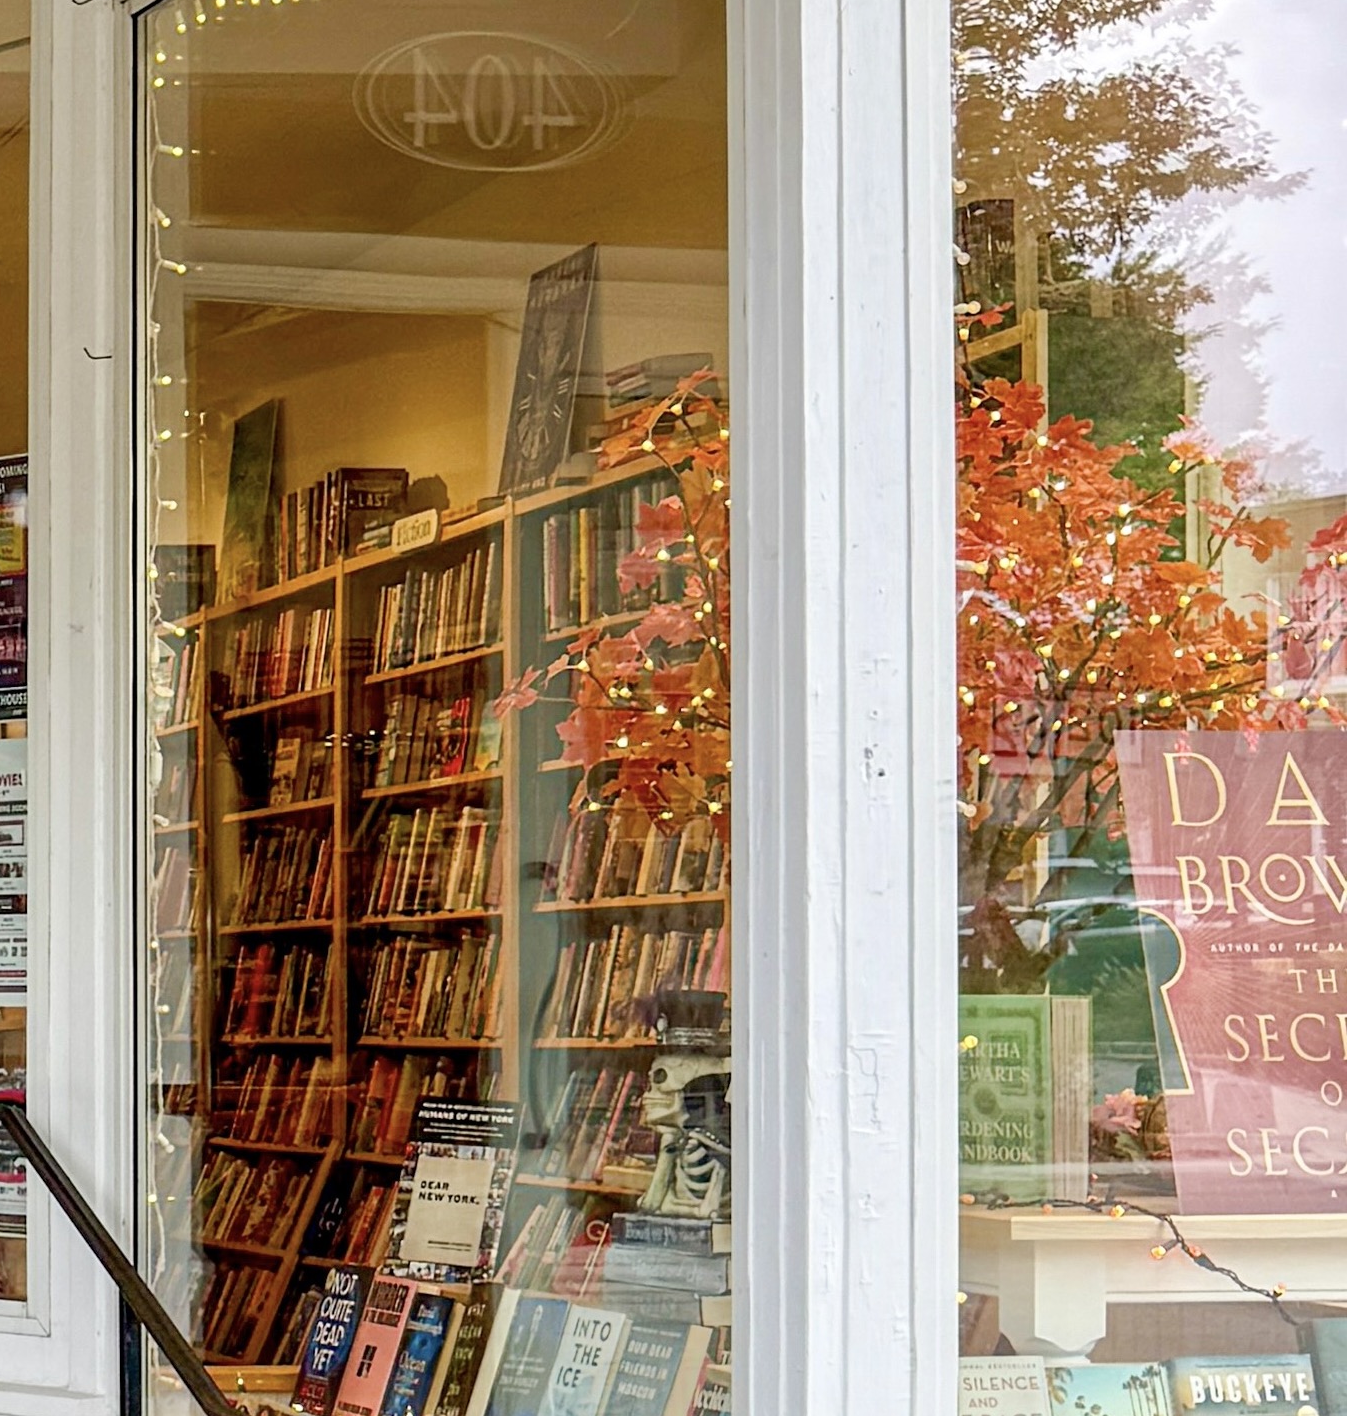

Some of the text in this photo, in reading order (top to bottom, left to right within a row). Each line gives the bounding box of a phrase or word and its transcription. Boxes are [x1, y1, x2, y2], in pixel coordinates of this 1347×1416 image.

[1210, 942, 1260, 953] AUTHOR
[1269, 942, 1285, 953] OF
[1295, 942, 1319, 953] THE
[1287, 968, 1347, 994] TH
[417, 1109, 515, 1125] HUMANS OF NEW YORK
[959, 1143, 1033, 1163] NDBOOK
[418, 1191, 445, 1202] NEW
[420, 1179, 450, 1191] DEAR
[331, 1270, 359, 1295] NOT
[320, 1296, 356, 1323] QUITE
[312, 1321, 345, 1347] DEAD
[572, 1316, 613, 1343] INTO
[311, 1348, 335, 1371] YET
[571, 1343, 602, 1368] THE
[556, 1366, 582, 1390] ICE
[962, 1375, 1041, 1392] SILENCE
[1189, 1372, 1311, 1405] BUCKEYE
[968, 1396, 999, 1409] AND
